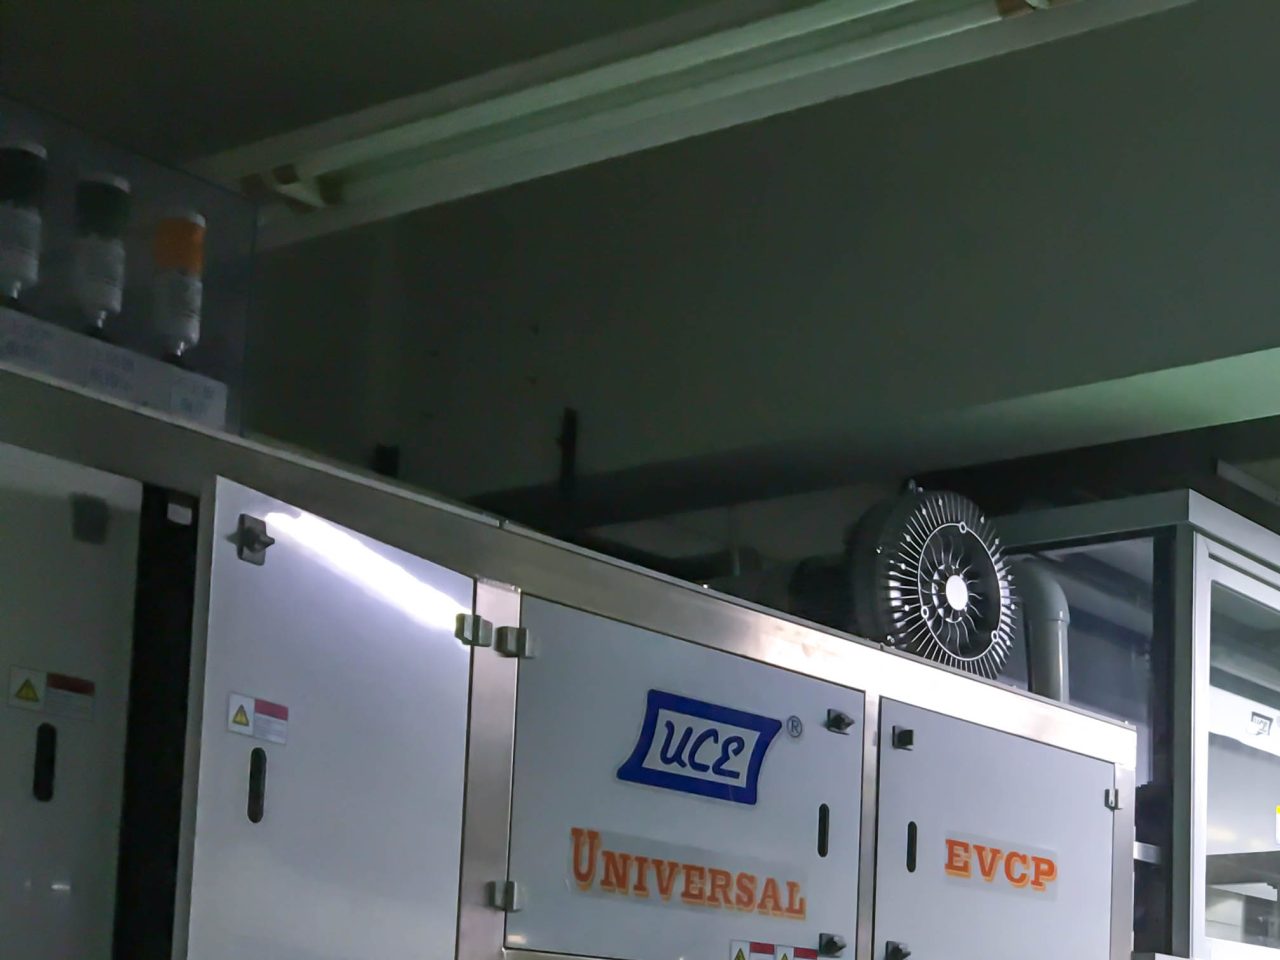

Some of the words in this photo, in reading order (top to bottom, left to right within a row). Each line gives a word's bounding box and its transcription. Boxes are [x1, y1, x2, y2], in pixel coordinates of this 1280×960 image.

[660, 720, 745, 779] UCE
[571, 827, 806, 920] UNIVERSAL
[944, 838, 1057, 891] EVCP
